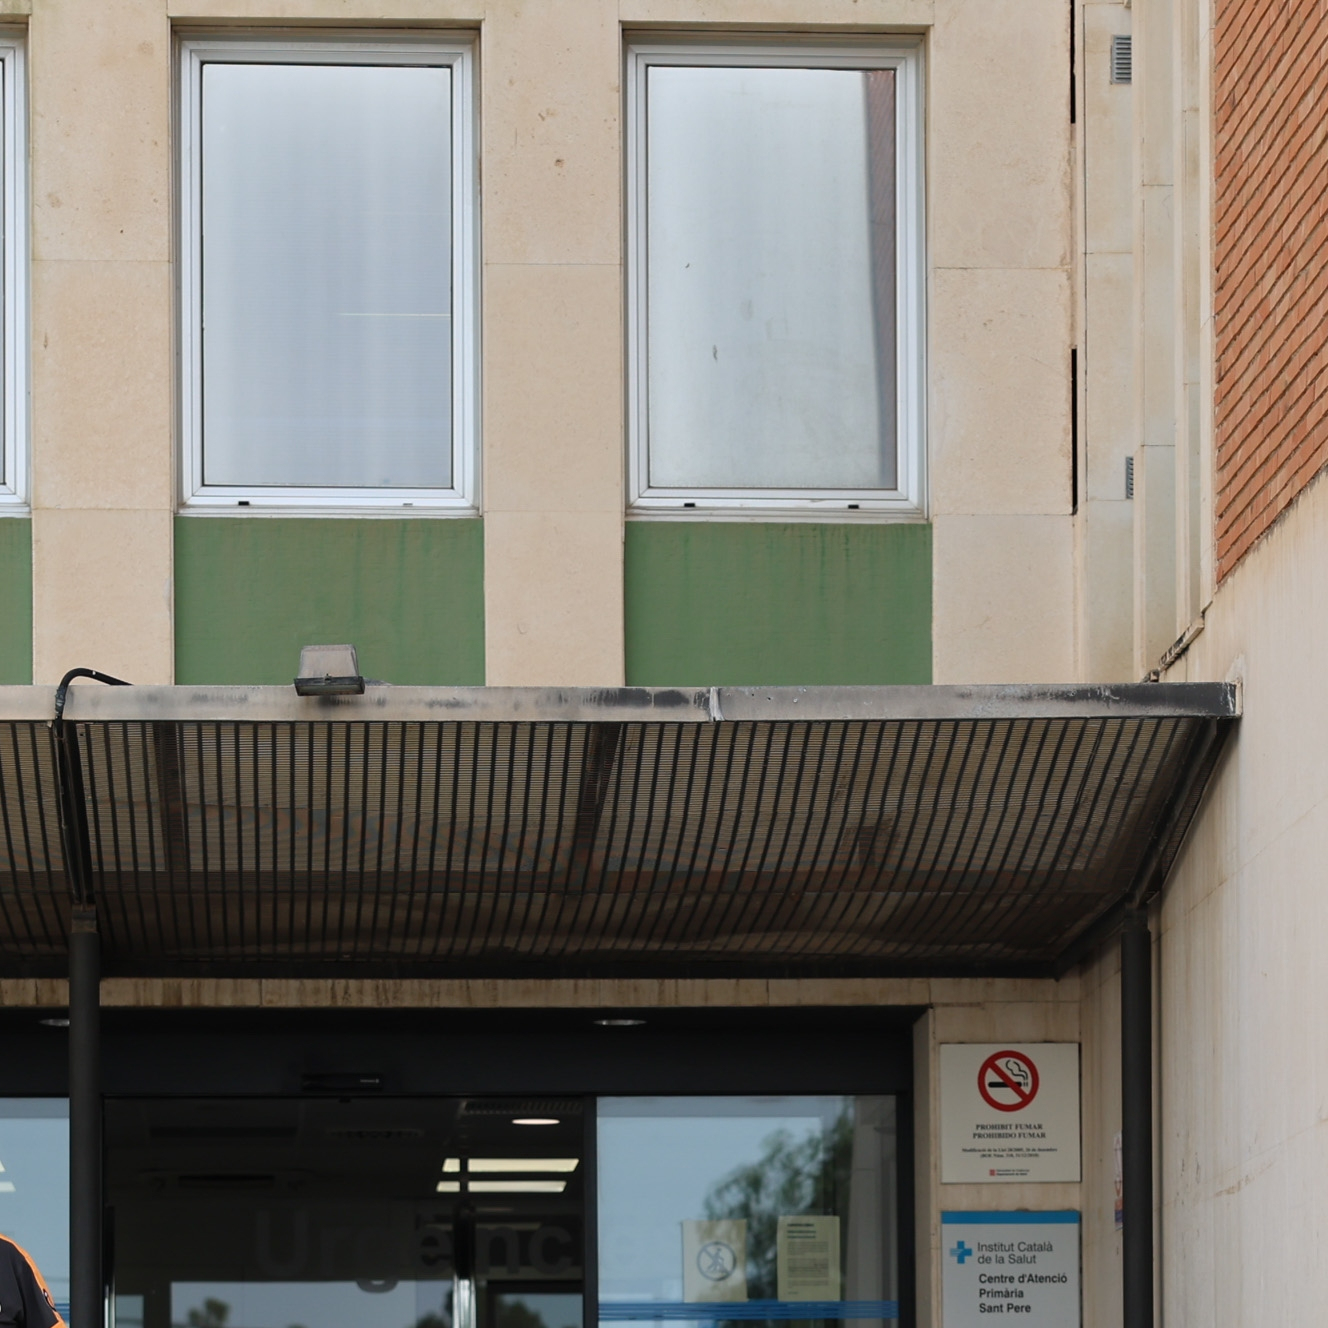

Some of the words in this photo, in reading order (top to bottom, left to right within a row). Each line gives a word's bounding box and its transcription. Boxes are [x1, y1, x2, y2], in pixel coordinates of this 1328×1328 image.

[255, 1209, 573, 1293] Urgènc
[977, 1242, 1015, 1253] Institut
[1017, 1241, 1053, 1253] Català
[977, 1254, 992, 1265] de
[995, 1254, 1005, 1265] la
[1008, 1253, 1037, 1265] Salut
[978, 1273, 1015, 1284] Centre
[1018, 1272, 1068, 1284] d'Atenció
[979, 1287, 1024, 1298] Primària
[979, 1303, 1004, 1313] Sant
[1007, 1303, 1031, 1313] Pere
